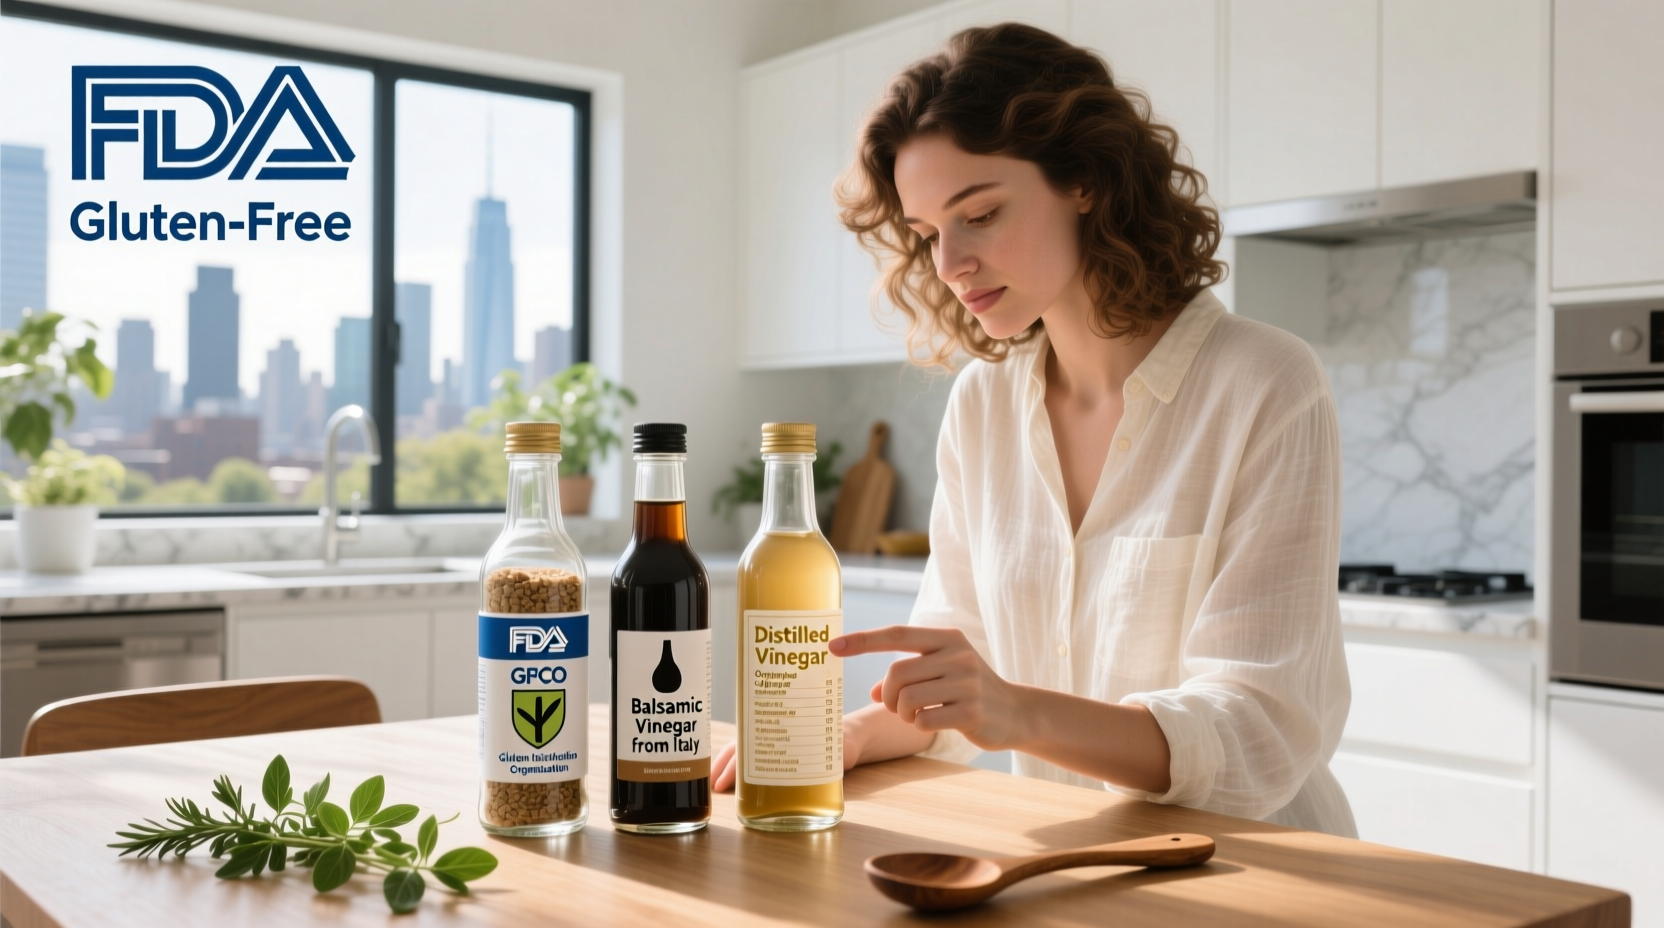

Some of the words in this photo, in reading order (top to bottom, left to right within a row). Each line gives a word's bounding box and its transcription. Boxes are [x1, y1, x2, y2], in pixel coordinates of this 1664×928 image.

[509, 626, 569, 653] FDA
[754, 624, 829, 644] Distilled
[755, 647, 829, 670] Vinegar
[631, 696, 703, 715] Balsamic
[635, 718, 697, 737] Vinegar
[632, 737, 669, 753] from
[673, 736, 700, 755] Italy
